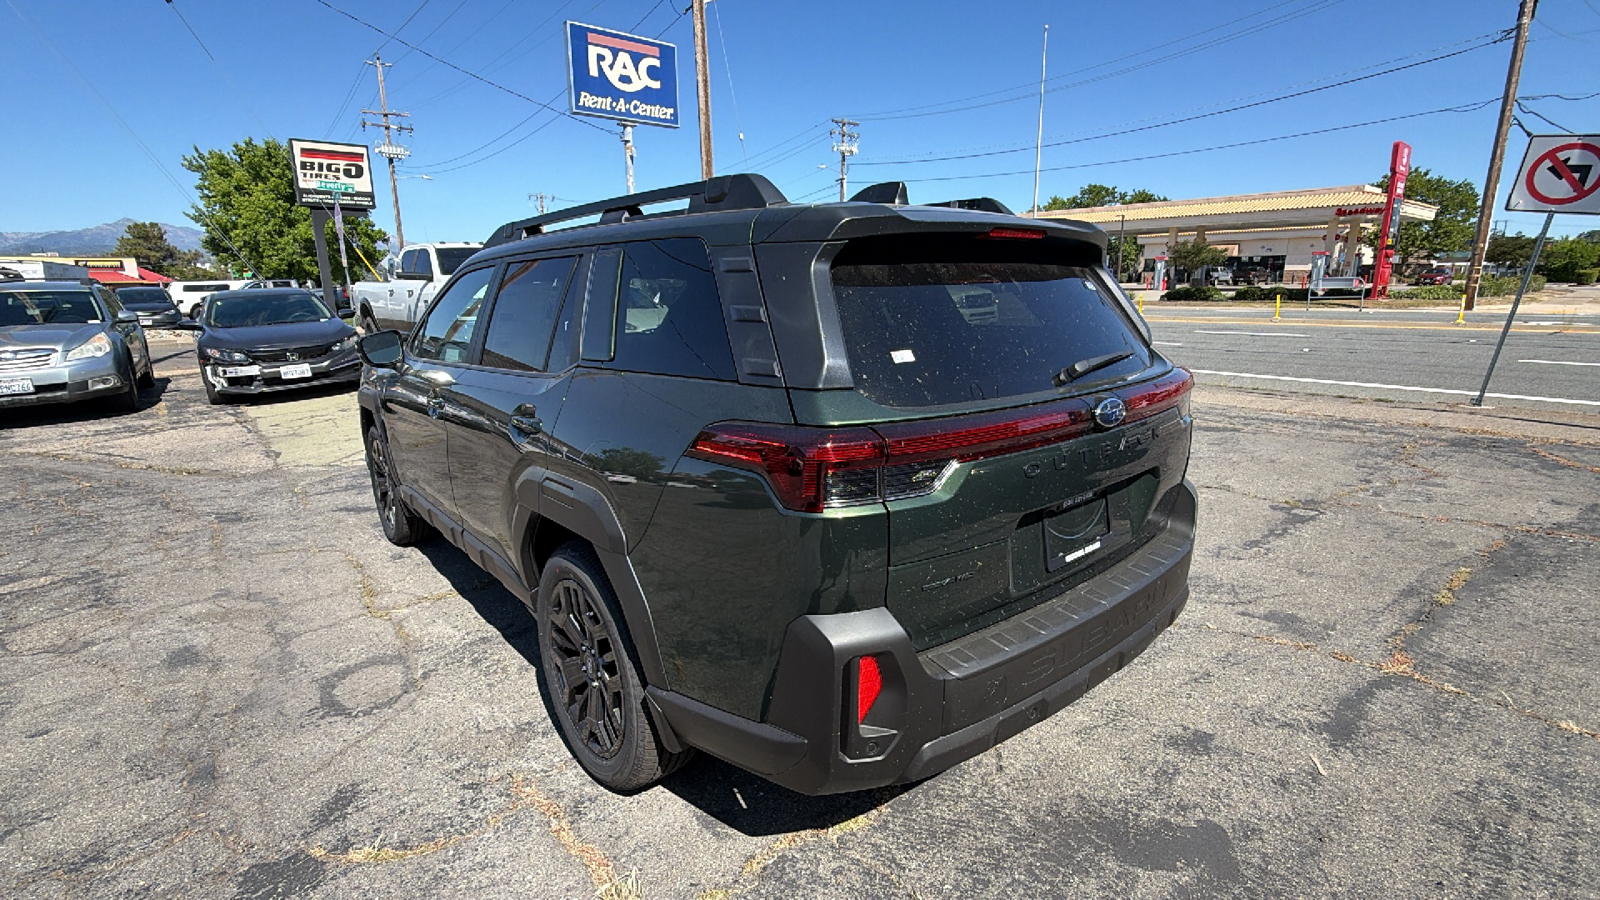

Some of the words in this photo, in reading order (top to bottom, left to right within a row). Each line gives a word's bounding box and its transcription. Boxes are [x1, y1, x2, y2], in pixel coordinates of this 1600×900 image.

[587, 44, 661, 92] RAC
[300, 161, 341, 173] BIG
[342, 163, 364, 179] O
[317, 181, 346, 191] Beverly
[1022, 580, 1168, 686] SUBARU
